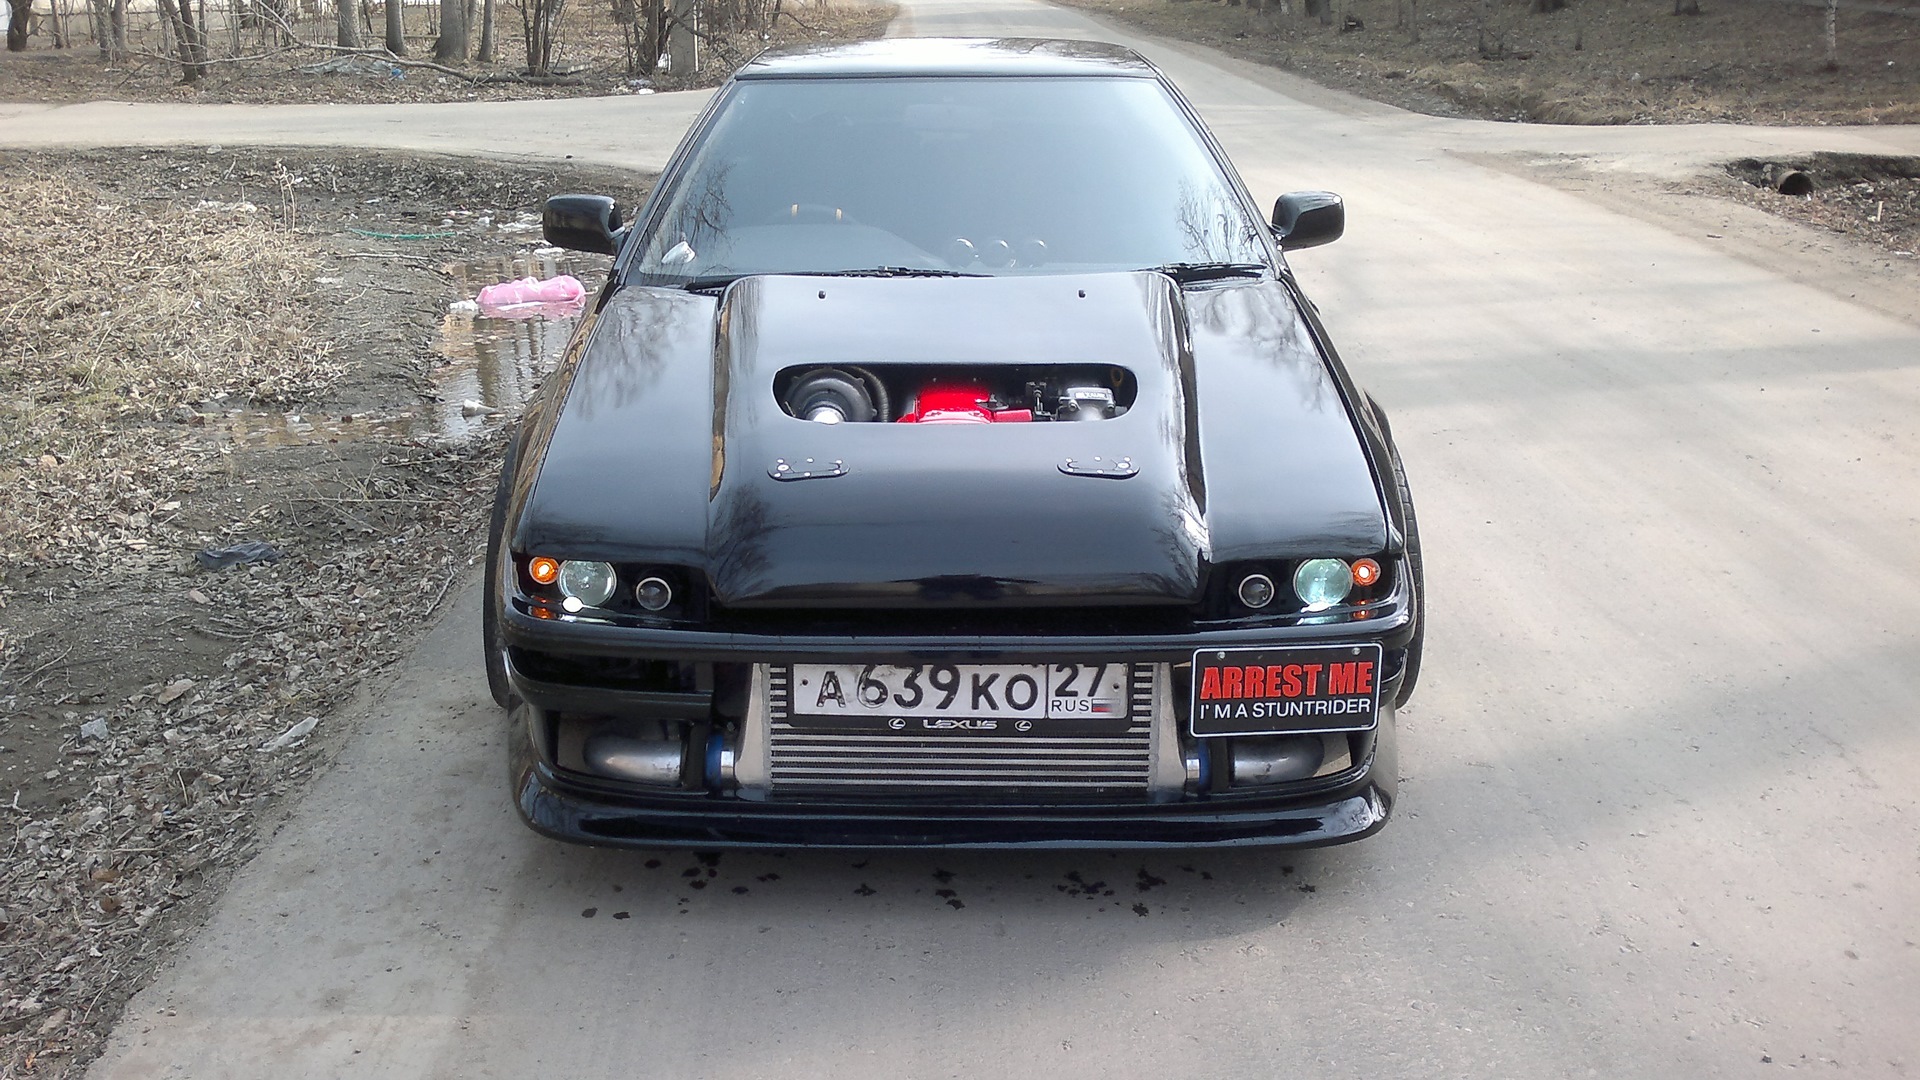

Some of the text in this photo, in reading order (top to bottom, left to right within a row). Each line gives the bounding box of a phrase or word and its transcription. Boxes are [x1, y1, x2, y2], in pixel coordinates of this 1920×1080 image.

[1054, 663, 1108, 698] 27
[1200, 661, 1374, 700] ARREST ME
[1050, 699, 1090, 713] RUS
[1235, 703, 1249, 719] A
[1252, 698, 1371, 718] STUNTRIDER
[922, 718, 998, 730] LEXUS
